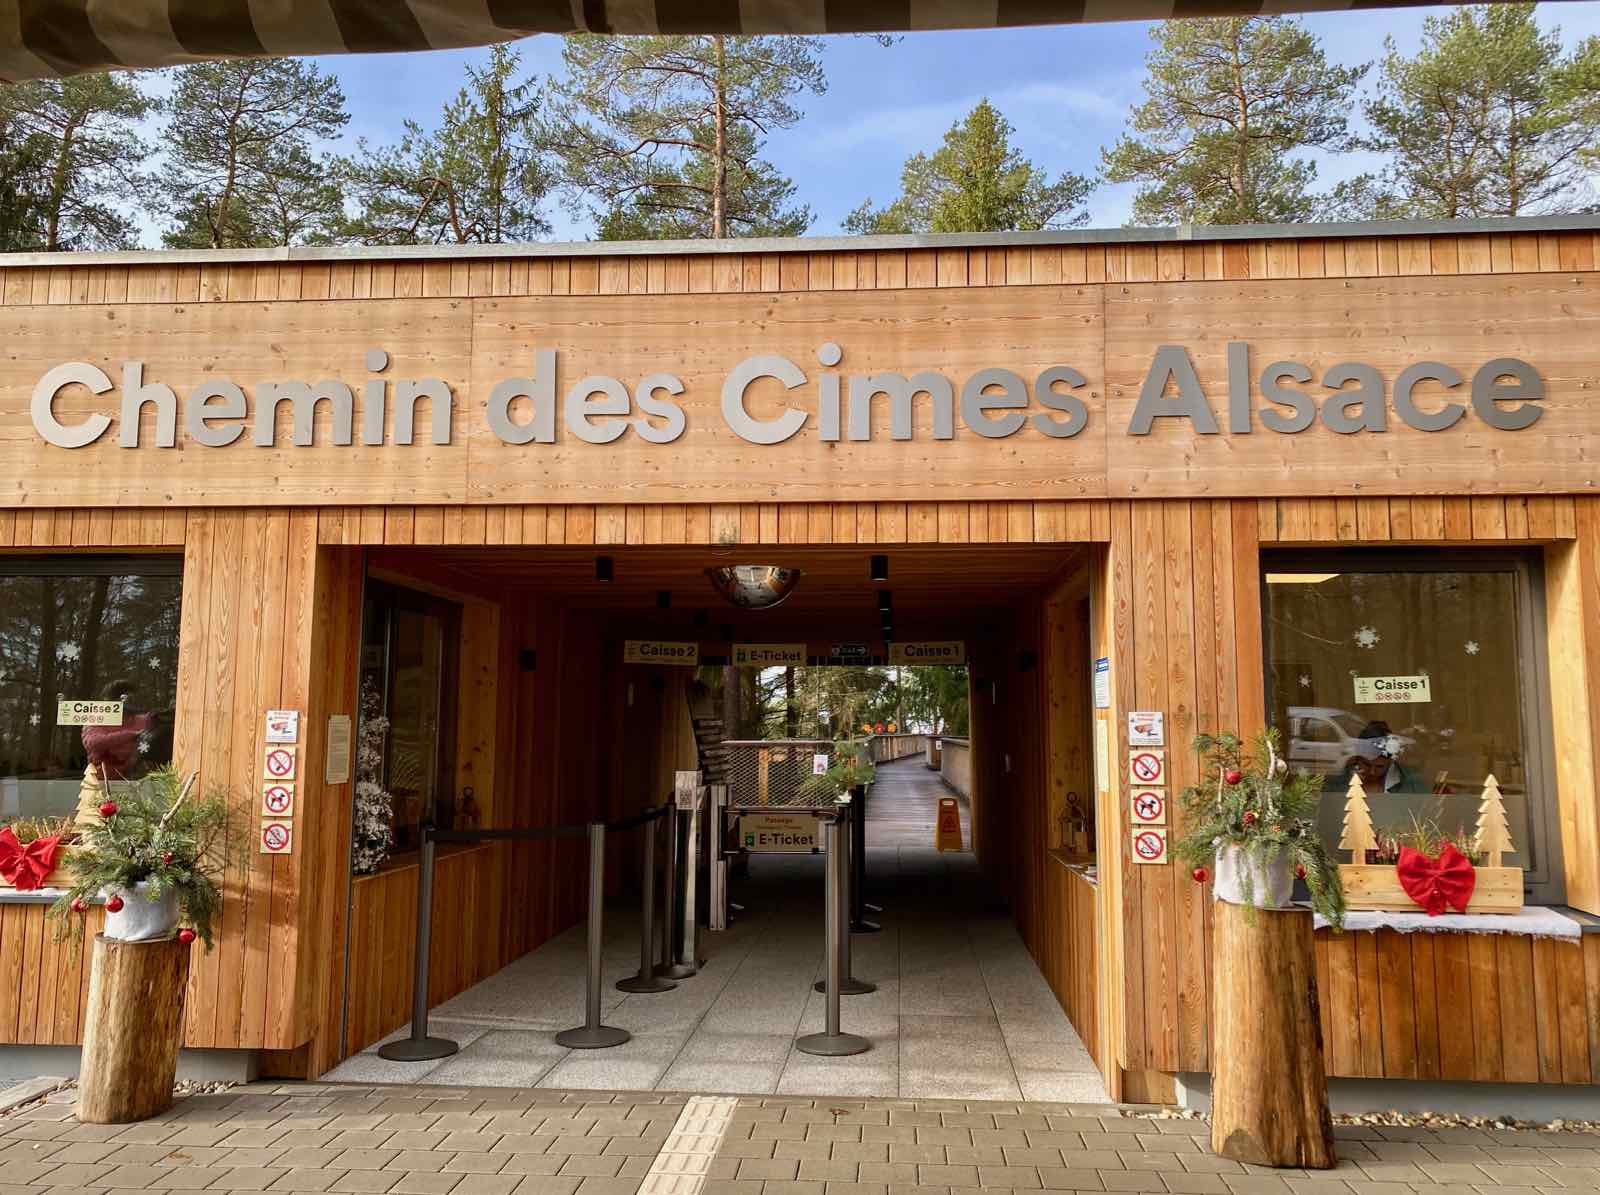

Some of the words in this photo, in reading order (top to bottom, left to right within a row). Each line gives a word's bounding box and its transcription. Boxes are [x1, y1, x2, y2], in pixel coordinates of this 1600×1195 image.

[30, 348, 453, 449] Chemin
[486, 349, 687, 445] des
[720, 342, 1089, 445] Cimes
[1126, 342, 1546, 436] Alsace
[640, 643, 685, 657] Caisse
[687, 645, 696, 657] 2
[750, 650, 801, 662] E-Ticket
[904, 644, 951, 657] Caisse
[953, 645, 960, 656] 1
[1374, 679, 1418, 690] Caisse
[1419, 679, 1426, 689] 1
[73, 702, 112, 713] Caisse
[113, 703, 120, 713] 2
[759, 833, 814, 845] E-Ticket
